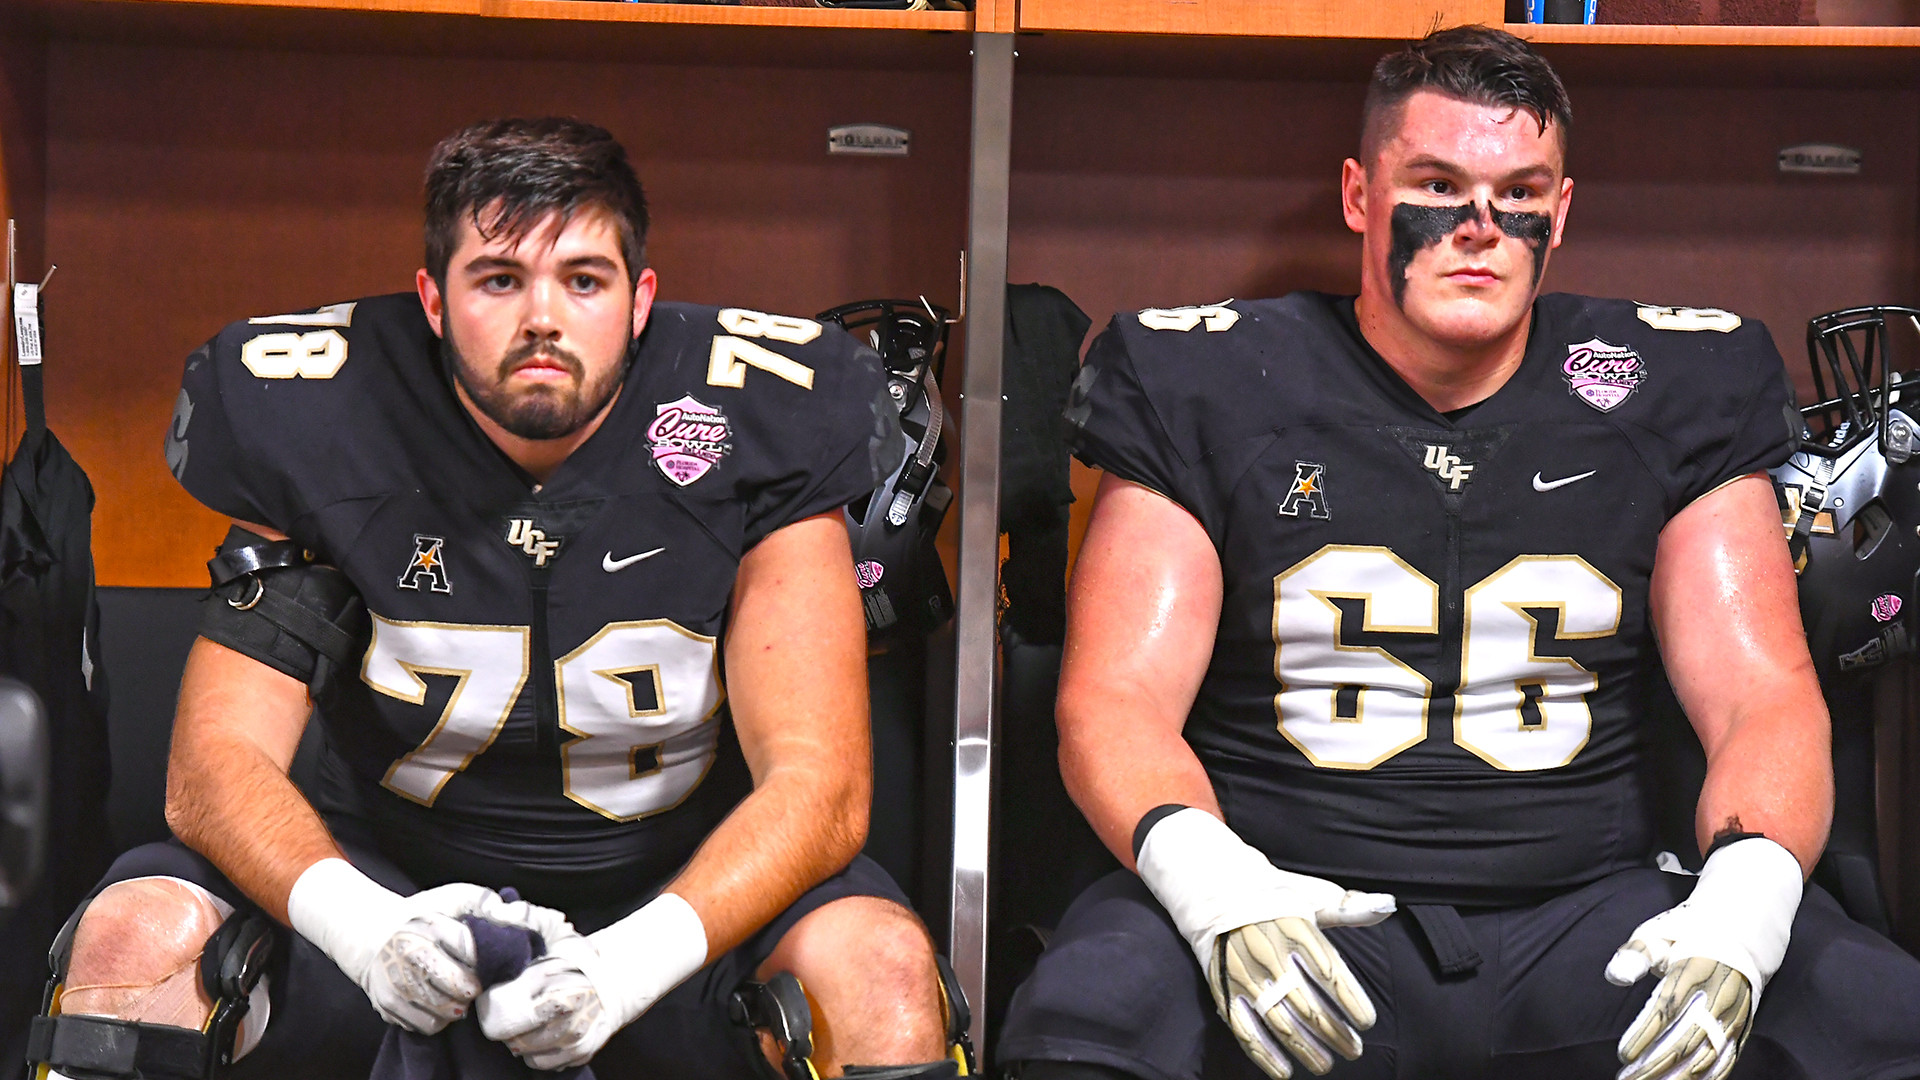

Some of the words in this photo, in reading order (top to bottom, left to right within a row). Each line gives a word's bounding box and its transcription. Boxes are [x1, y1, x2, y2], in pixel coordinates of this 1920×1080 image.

[240, 301, 358, 379] 78
[706, 307, 823, 391] 78
[1563, 348, 1640, 375] Cure
[1593, 351, 1638, 359] AutoNation
[1572, 371, 1639, 380] BOWL
[647, 407, 727, 442] Cure
[681, 412, 726, 424] AutoNation
[654, 438, 722, 452] BOWL
[1424, 445, 1474, 490] UCF
[1278, 462, 1331, 520] A
[399, 536, 451, 594] A
[507, 519, 559, 566] UCF
[1271, 544, 1623, 772] 66
[360, 608, 726, 823] 78
